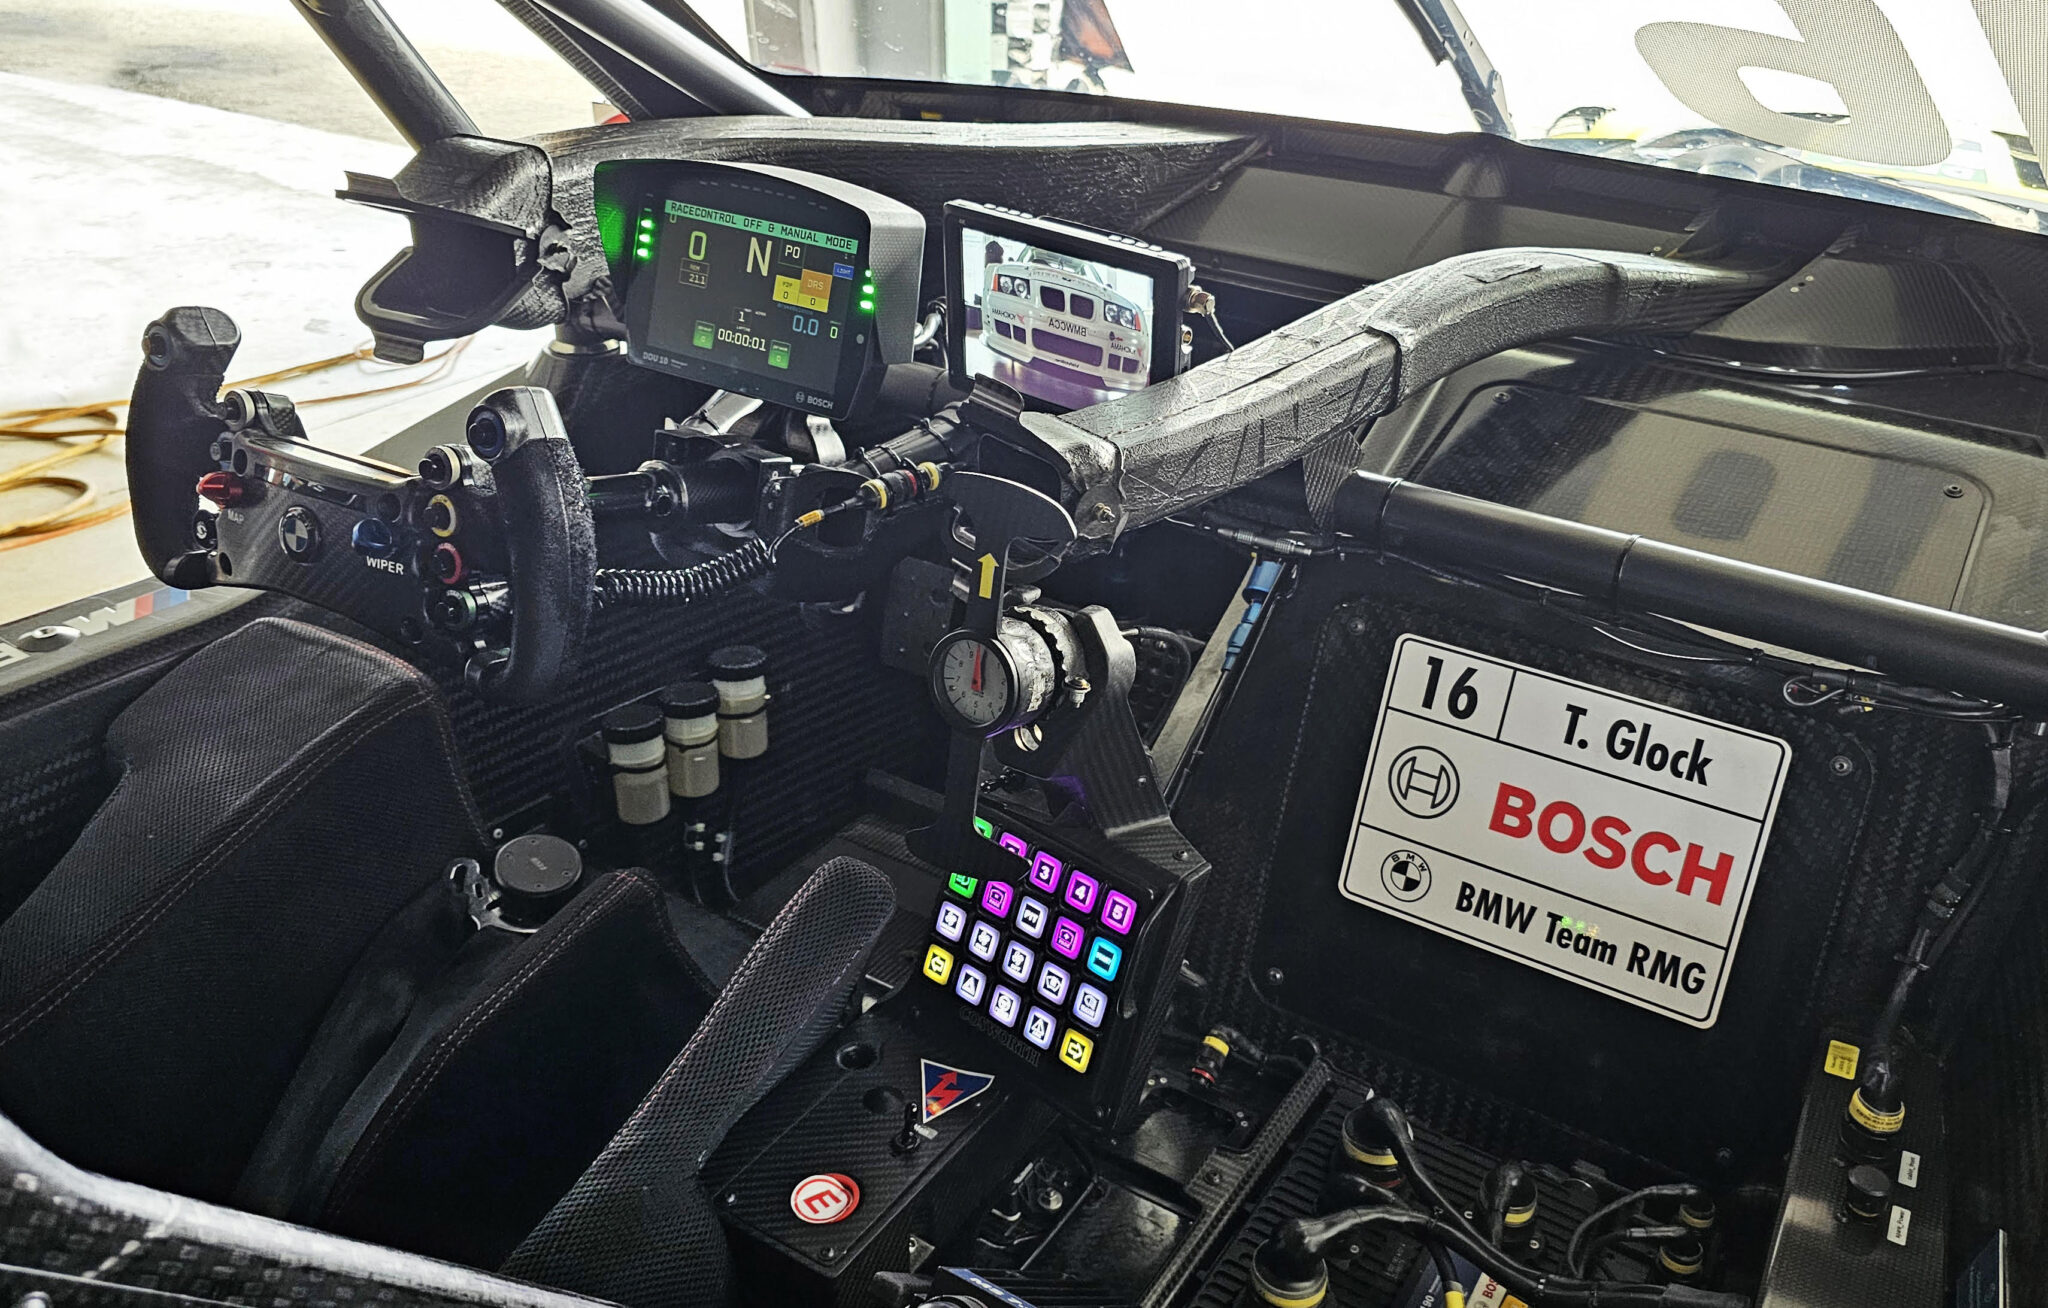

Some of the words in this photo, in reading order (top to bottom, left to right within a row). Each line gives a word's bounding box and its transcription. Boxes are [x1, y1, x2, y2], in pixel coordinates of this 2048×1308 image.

[670, 202, 736, 225] RACECONTROL
[743, 218, 763, 230] OFF
[767, 223, 775, 233] &
[780, 226, 819, 243] MANUAL
[825, 237, 852, 250] MODE
[688, 230, 708, 261] 0
[746, 236, 773, 277] N
[688, 273, 706, 285] 211
[807, 278, 824, 290] DRS
[783, 291, 789, 300] 0
[810, 297, 816, 306] 0
[738, 311, 746, 322] 1
[792, 314, 819, 337] 0.0
[717, 328, 766, 352] 00:00:01
[829, 326, 838, 339] 0
[643, 350, 658, 363] DDU
[807, 395, 834, 410] BOSCH
[366, 555, 404, 576] WIPER
[1420, 656, 1479, 721] 16
[1562, 703, 1590, 750] T.
[1605, 718, 1713, 786] Glock
[1487, 782, 1734, 907] BOSCH
[1039, 864, 1050, 880] 3
[1391, 853, 1427, 872] BMW
[1074, 884, 1086, 900] 4
[1111, 905, 1124, 921] 5
[1455, 881, 1538, 935] BMW
[1543, 911, 1619, 966] Team
[1626, 941, 1707, 995] RMG
[803, 1189, 842, 1215] E
